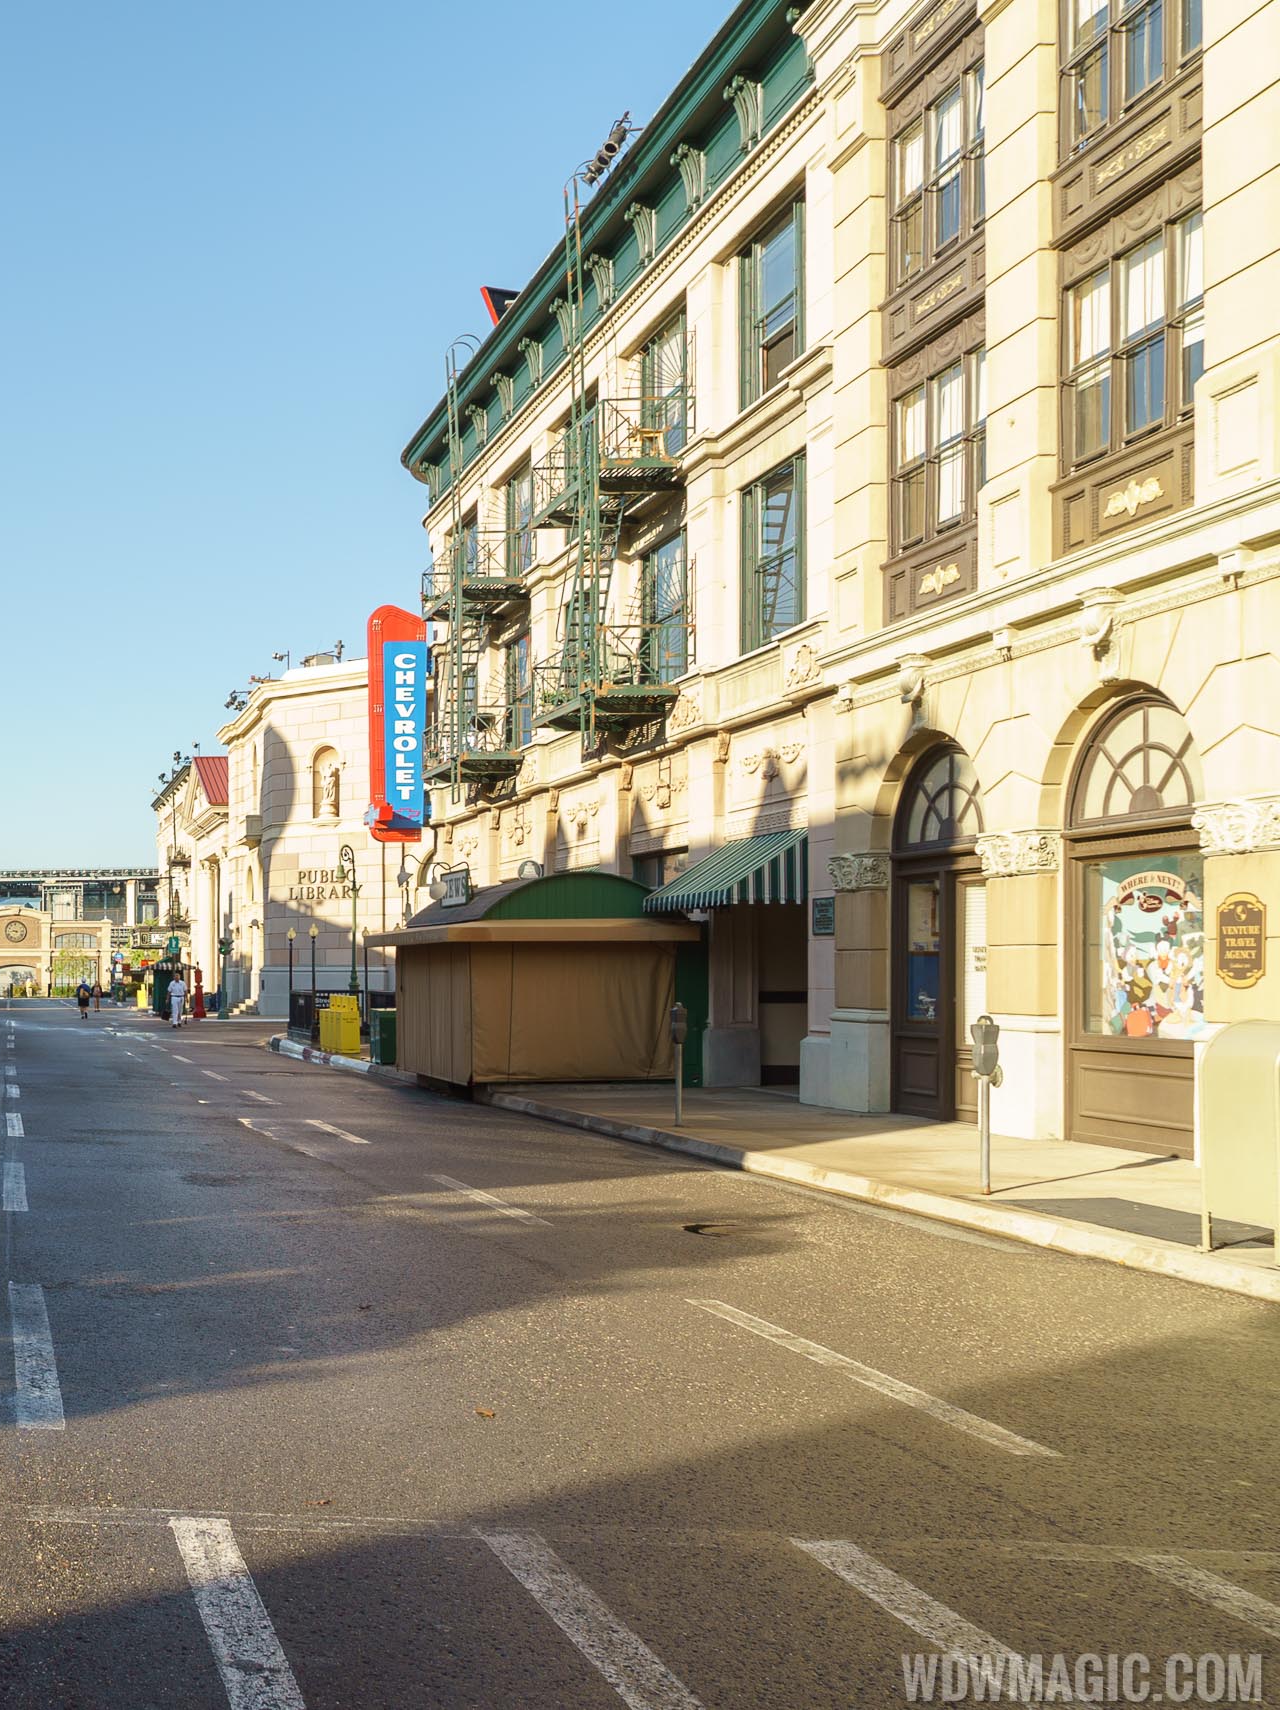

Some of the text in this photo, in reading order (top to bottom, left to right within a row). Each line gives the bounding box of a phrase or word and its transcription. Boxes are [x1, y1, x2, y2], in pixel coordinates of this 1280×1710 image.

[393, 653, 418, 801] CHEVROLET
[298, 869, 356, 885] PUBLC
[1121, 876, 1149, 892] WHERE
[289, 885, 363, 900] LIBRARY
[1222, 925, 1260, 935] VENTURE
[1225, 938, 1256, 946] TRAVEL
[1224, 950, 1257, 959] AGENCY
